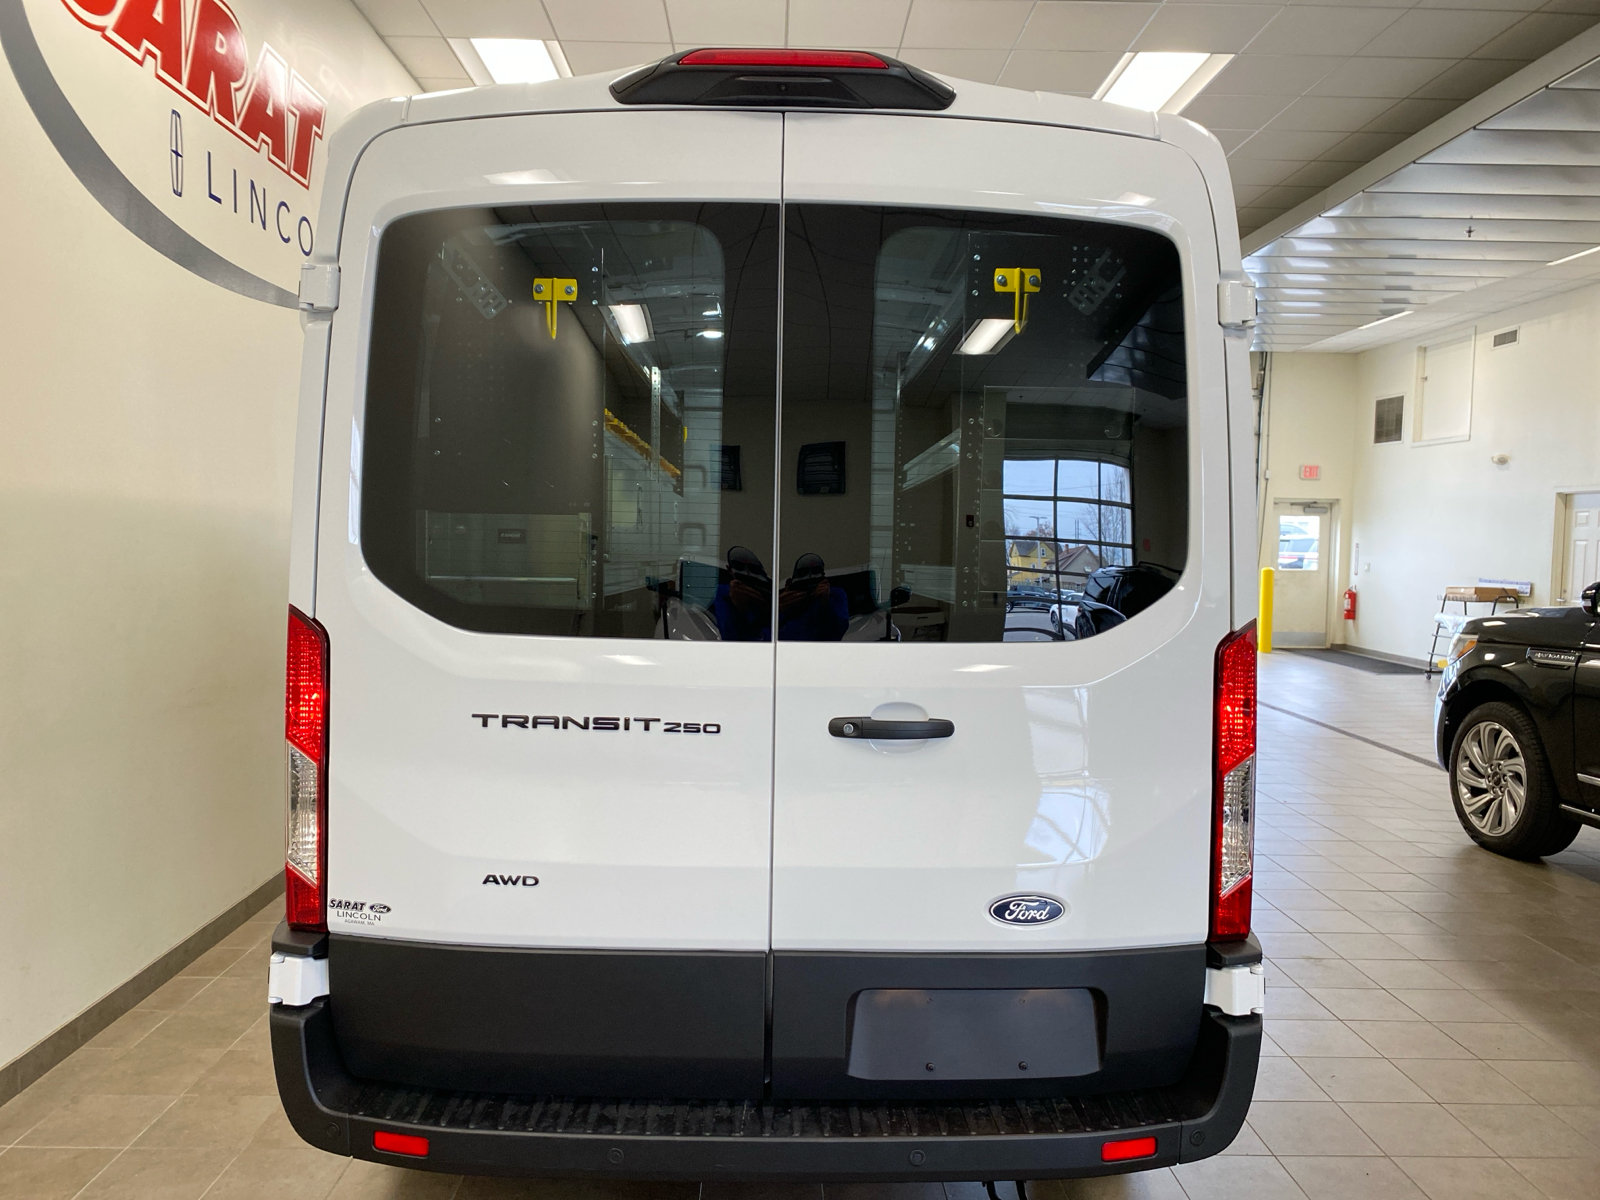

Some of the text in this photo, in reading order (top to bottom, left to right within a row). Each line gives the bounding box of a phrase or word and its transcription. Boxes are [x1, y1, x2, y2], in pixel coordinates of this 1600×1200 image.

[206, 150, 314, 257] LINCO
[1303, 465, 1319, 478] EXIT
[471, 713, 721, 734] TRANSIT 250
[482, 873, 539, 887] AWD
[329, 898, 366, 911] SARAT
[1004, 899, 1051, 920] Ford
[336, 910, 381, 921] LINCOLN
